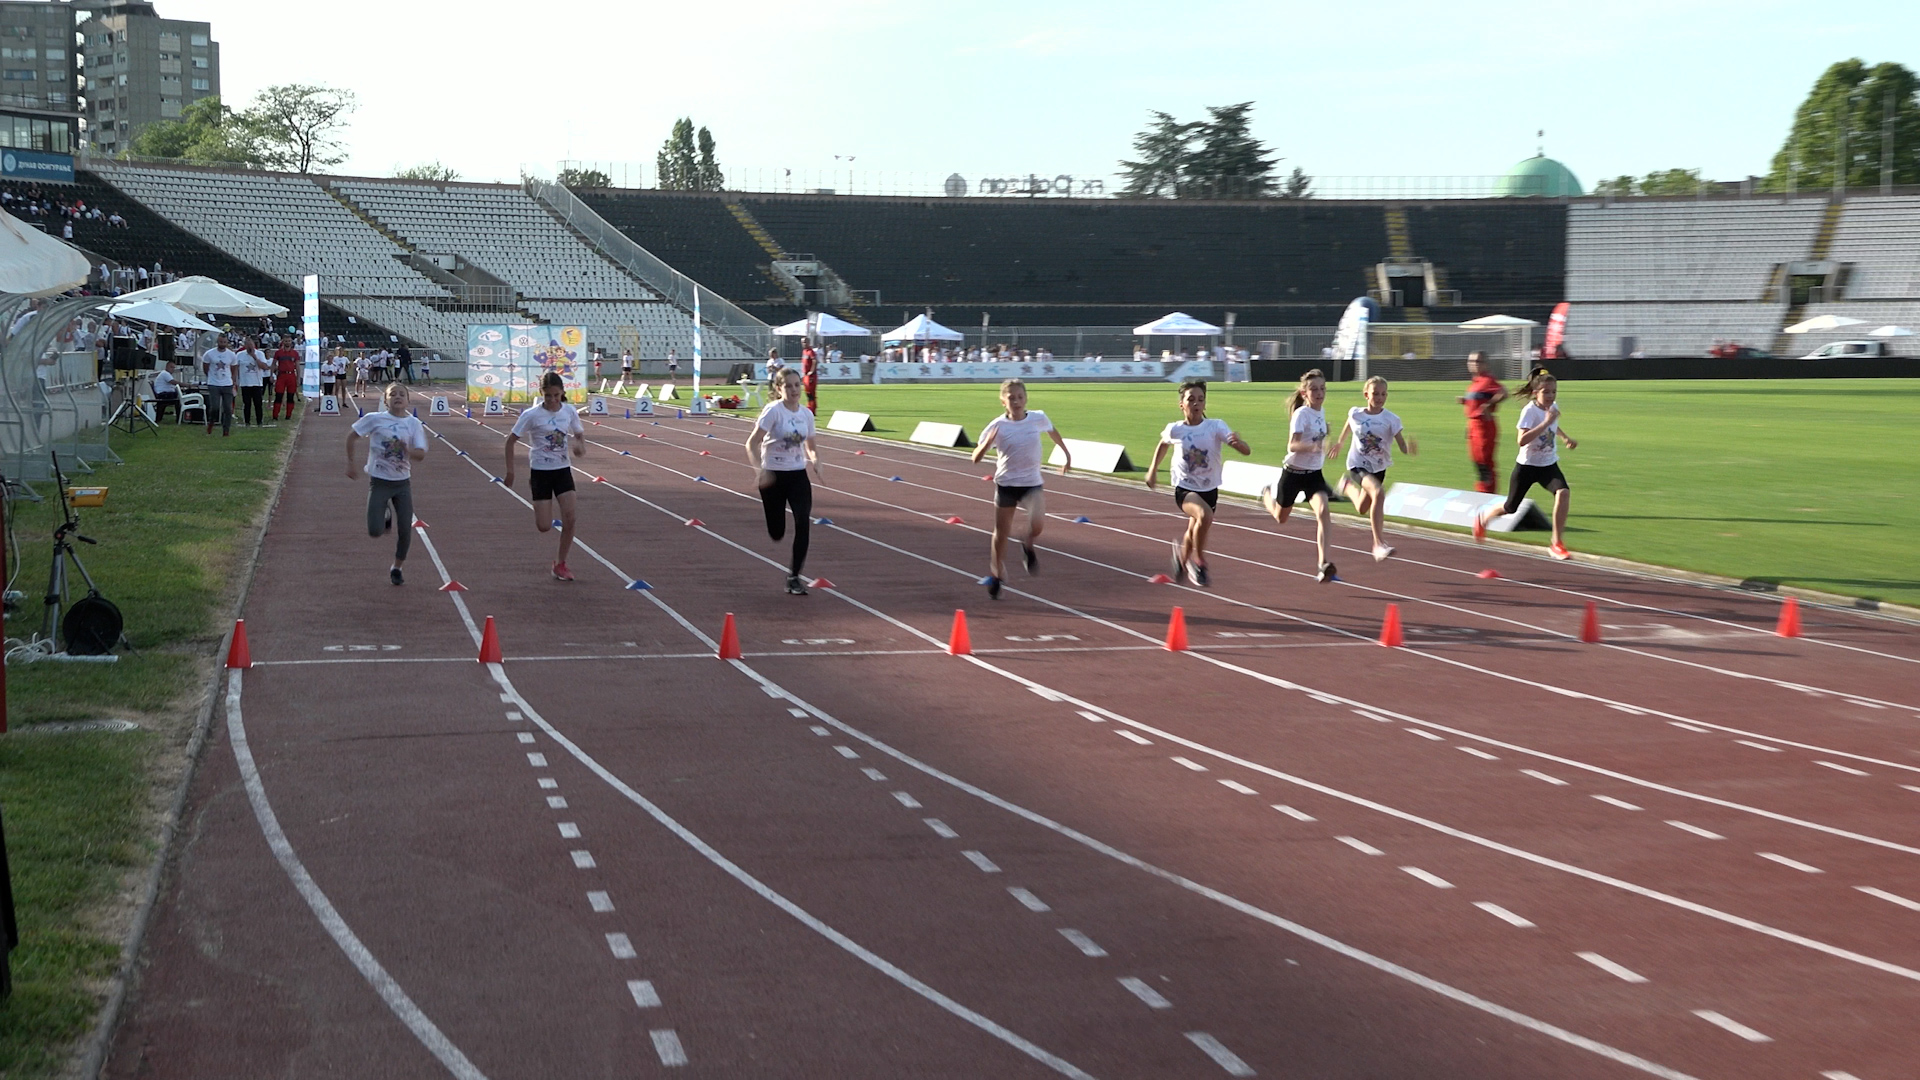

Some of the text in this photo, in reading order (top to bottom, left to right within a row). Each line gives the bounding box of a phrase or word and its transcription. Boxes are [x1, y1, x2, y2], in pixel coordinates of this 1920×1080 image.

[326, 399, 334, 411] 8
[436, 400, 445, 412] 6
[490, 400, 498, 411] 5
[595, 401, 603, 412] 3
[641, 401, 648, 412] 2
[695, 401, 702, 412] 1
